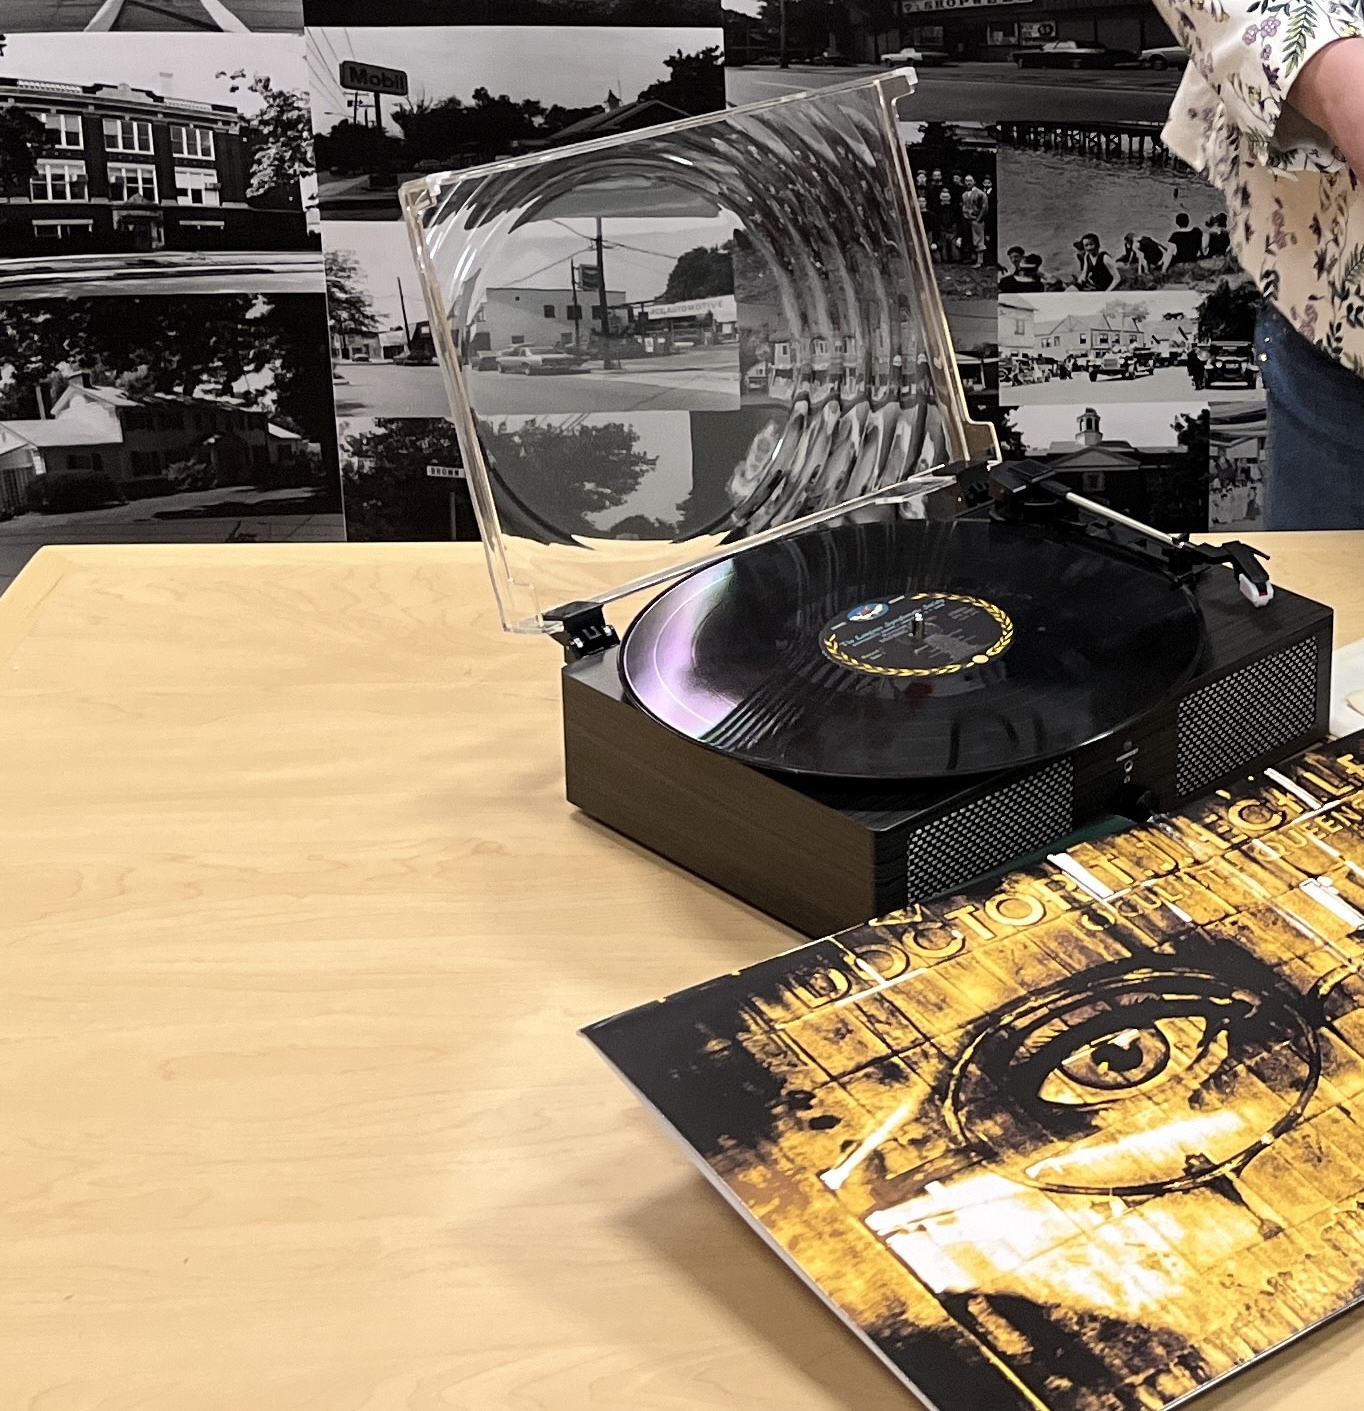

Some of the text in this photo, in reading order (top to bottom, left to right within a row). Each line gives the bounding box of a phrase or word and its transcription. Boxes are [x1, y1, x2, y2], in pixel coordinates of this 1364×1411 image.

[349, 66, 405, 90] Mobil
[667, 300, 723, 314] AUTOMOTIVE
[788, 873, 1093, 1009] DOCTOR
